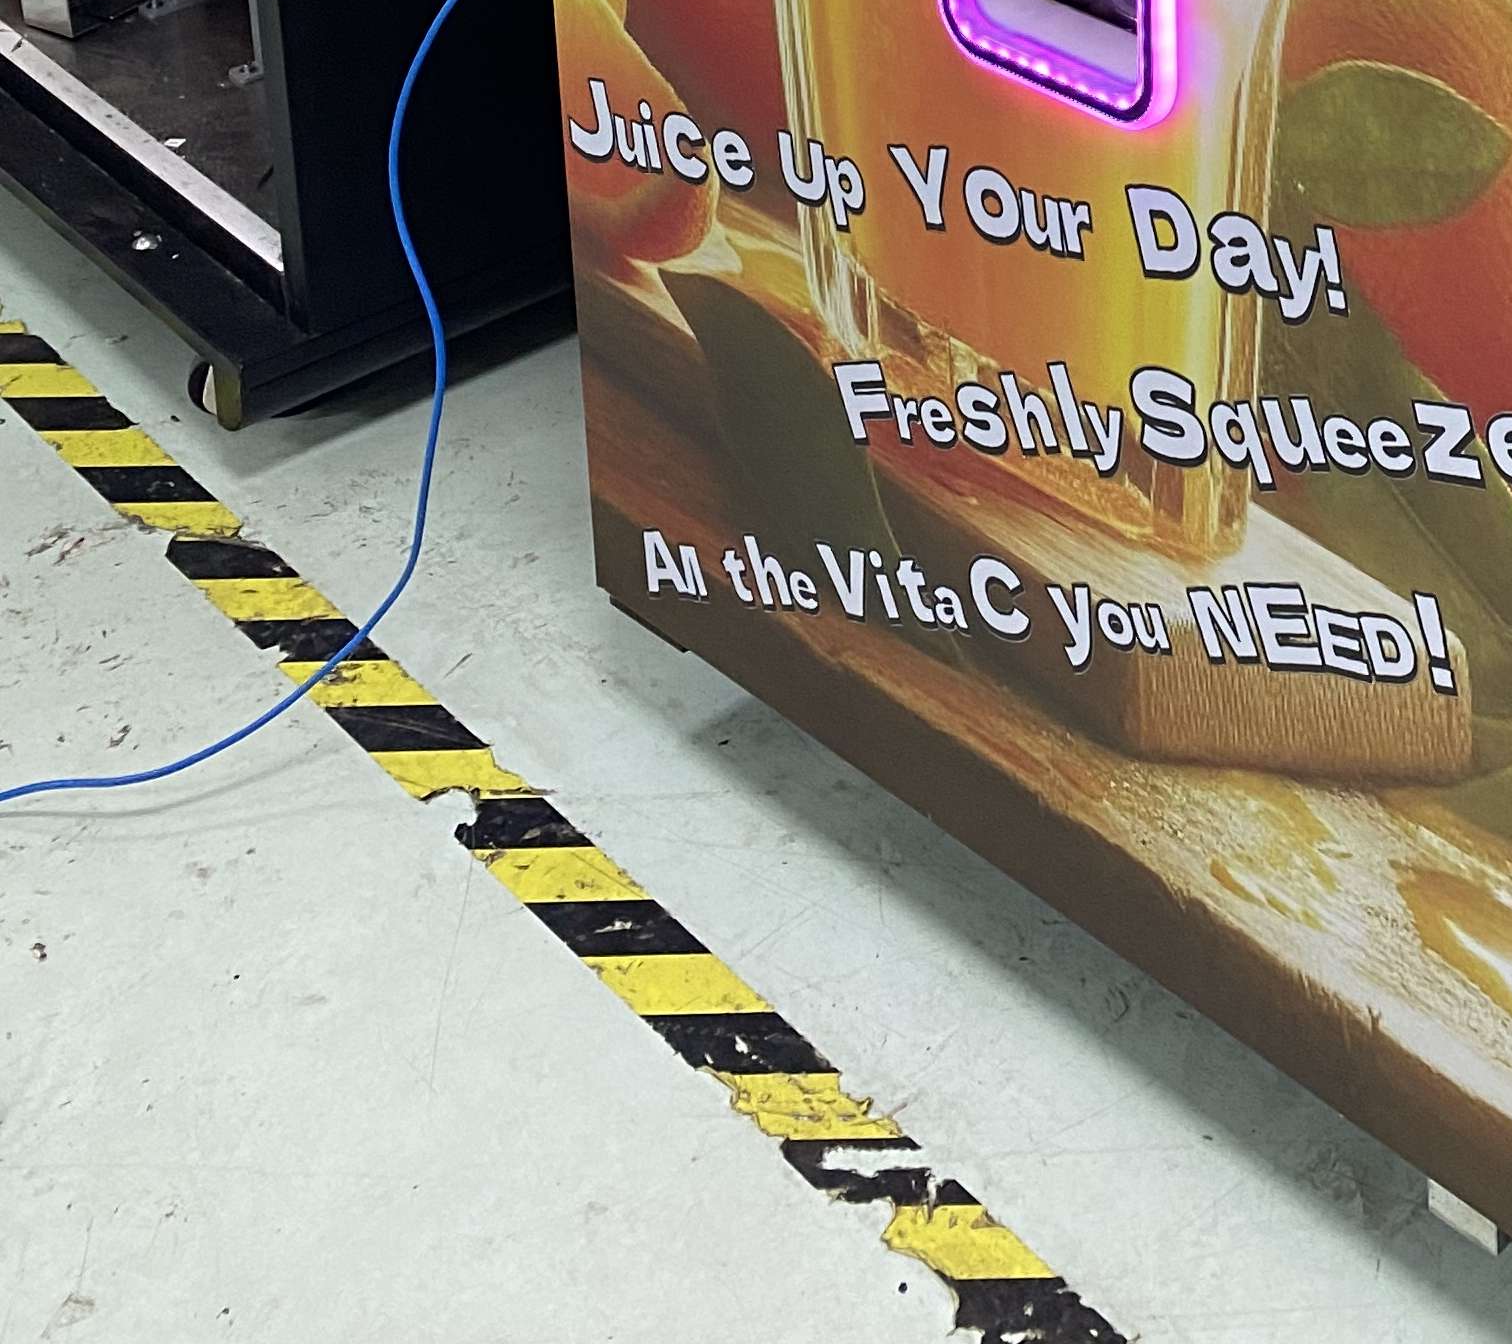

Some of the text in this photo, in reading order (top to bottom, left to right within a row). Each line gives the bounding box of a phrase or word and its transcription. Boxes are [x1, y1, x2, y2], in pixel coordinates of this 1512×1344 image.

[777, 130, 866, 232] Up
[1125, 184, 1349, 325] Day!
[832, 361, 1123, 476] Freshly
[721, 533, 820, 616] the
[1047, 583, 1171, 674] you
[1187, 581, 1458, 696] NEED!
